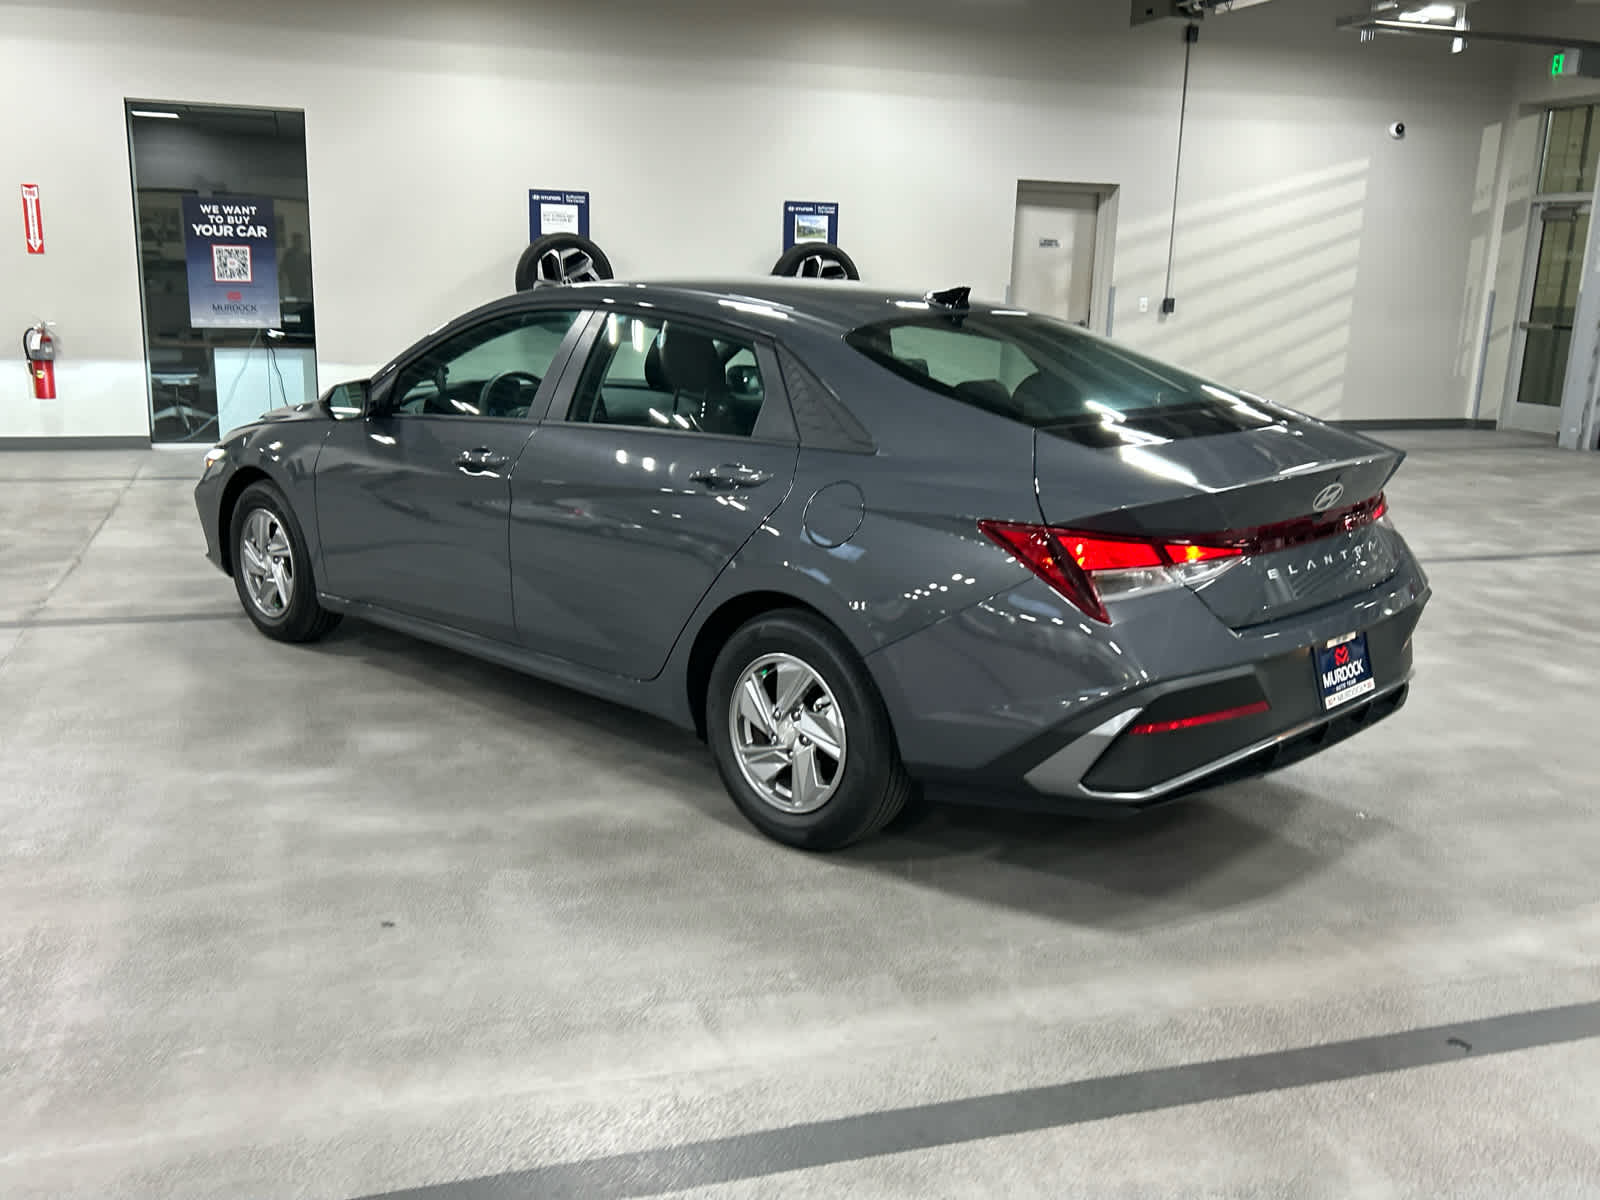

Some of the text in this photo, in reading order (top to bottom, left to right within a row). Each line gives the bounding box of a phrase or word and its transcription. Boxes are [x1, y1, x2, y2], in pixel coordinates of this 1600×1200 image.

[200, 204, 257, 215] WE WANT
[208, 214, 250, 224] TO BUY
[192, 223, 268, 238] YOUR CAR
[1267, 541, 1377, 580] ELANTRA
[1322, 658, 1364, 689] MURDOCK
